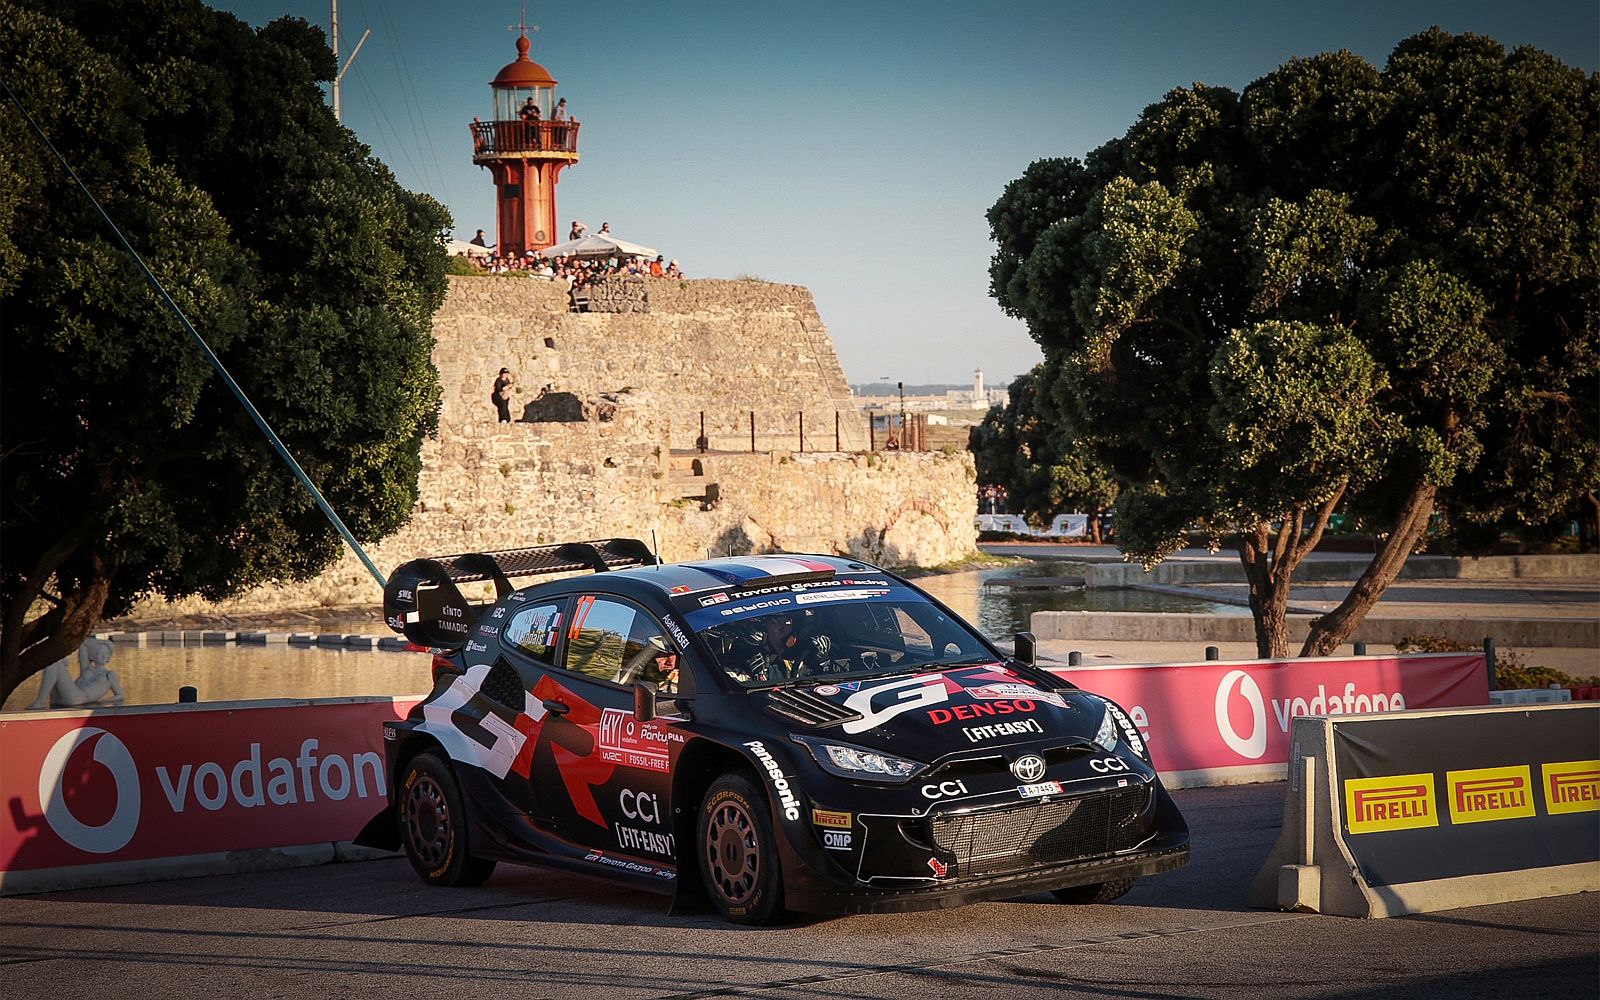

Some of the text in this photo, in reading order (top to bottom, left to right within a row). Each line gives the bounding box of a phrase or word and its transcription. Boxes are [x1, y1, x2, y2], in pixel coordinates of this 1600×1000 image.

[842, 578, 889, 587] Racing
[438, 620, 469, 635] TAMADIC
[567, 595, 596, 640] 17
[927, 698, 1037, 726] DENSO
[668, 732, 685, 743] PIAA
[743, 740, 801, 822] Panasonic
[1455, 776, 1526, 813] PIRELLI
[1353, 784, 1428, 823] PIRELLI
[824, 833, 852, 847] OMP
